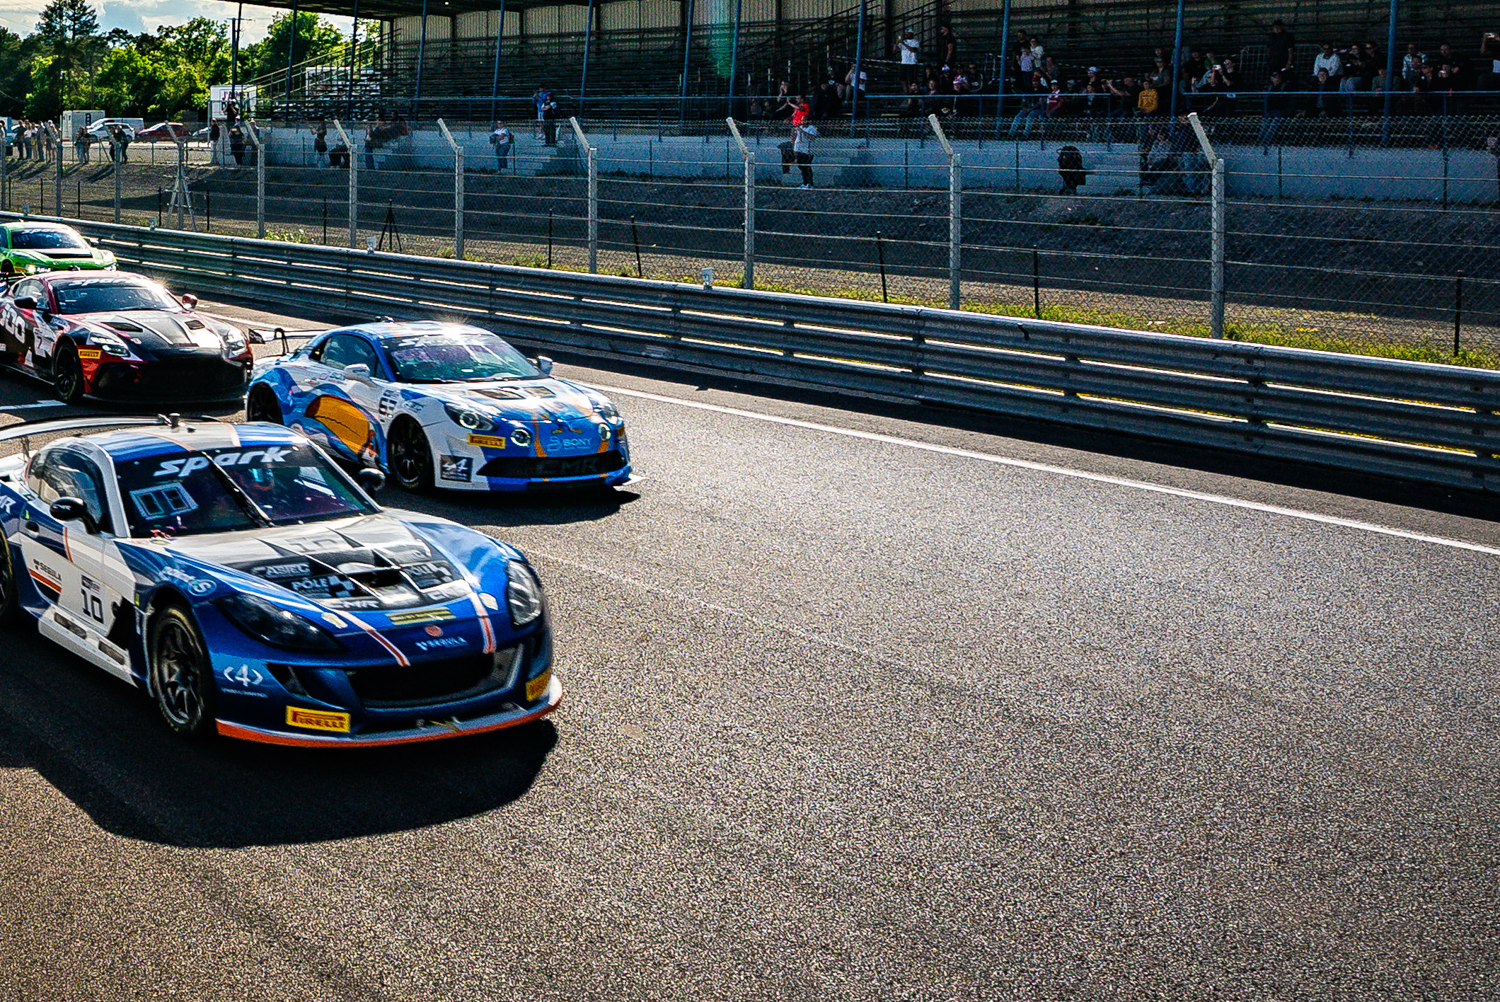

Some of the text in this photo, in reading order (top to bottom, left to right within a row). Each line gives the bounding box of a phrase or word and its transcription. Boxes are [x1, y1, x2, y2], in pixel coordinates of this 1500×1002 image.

[153, 446, 292, 478] spark
[81, 588, 104, 624] 10
[291, 710, 345, 729] PIRELLI
